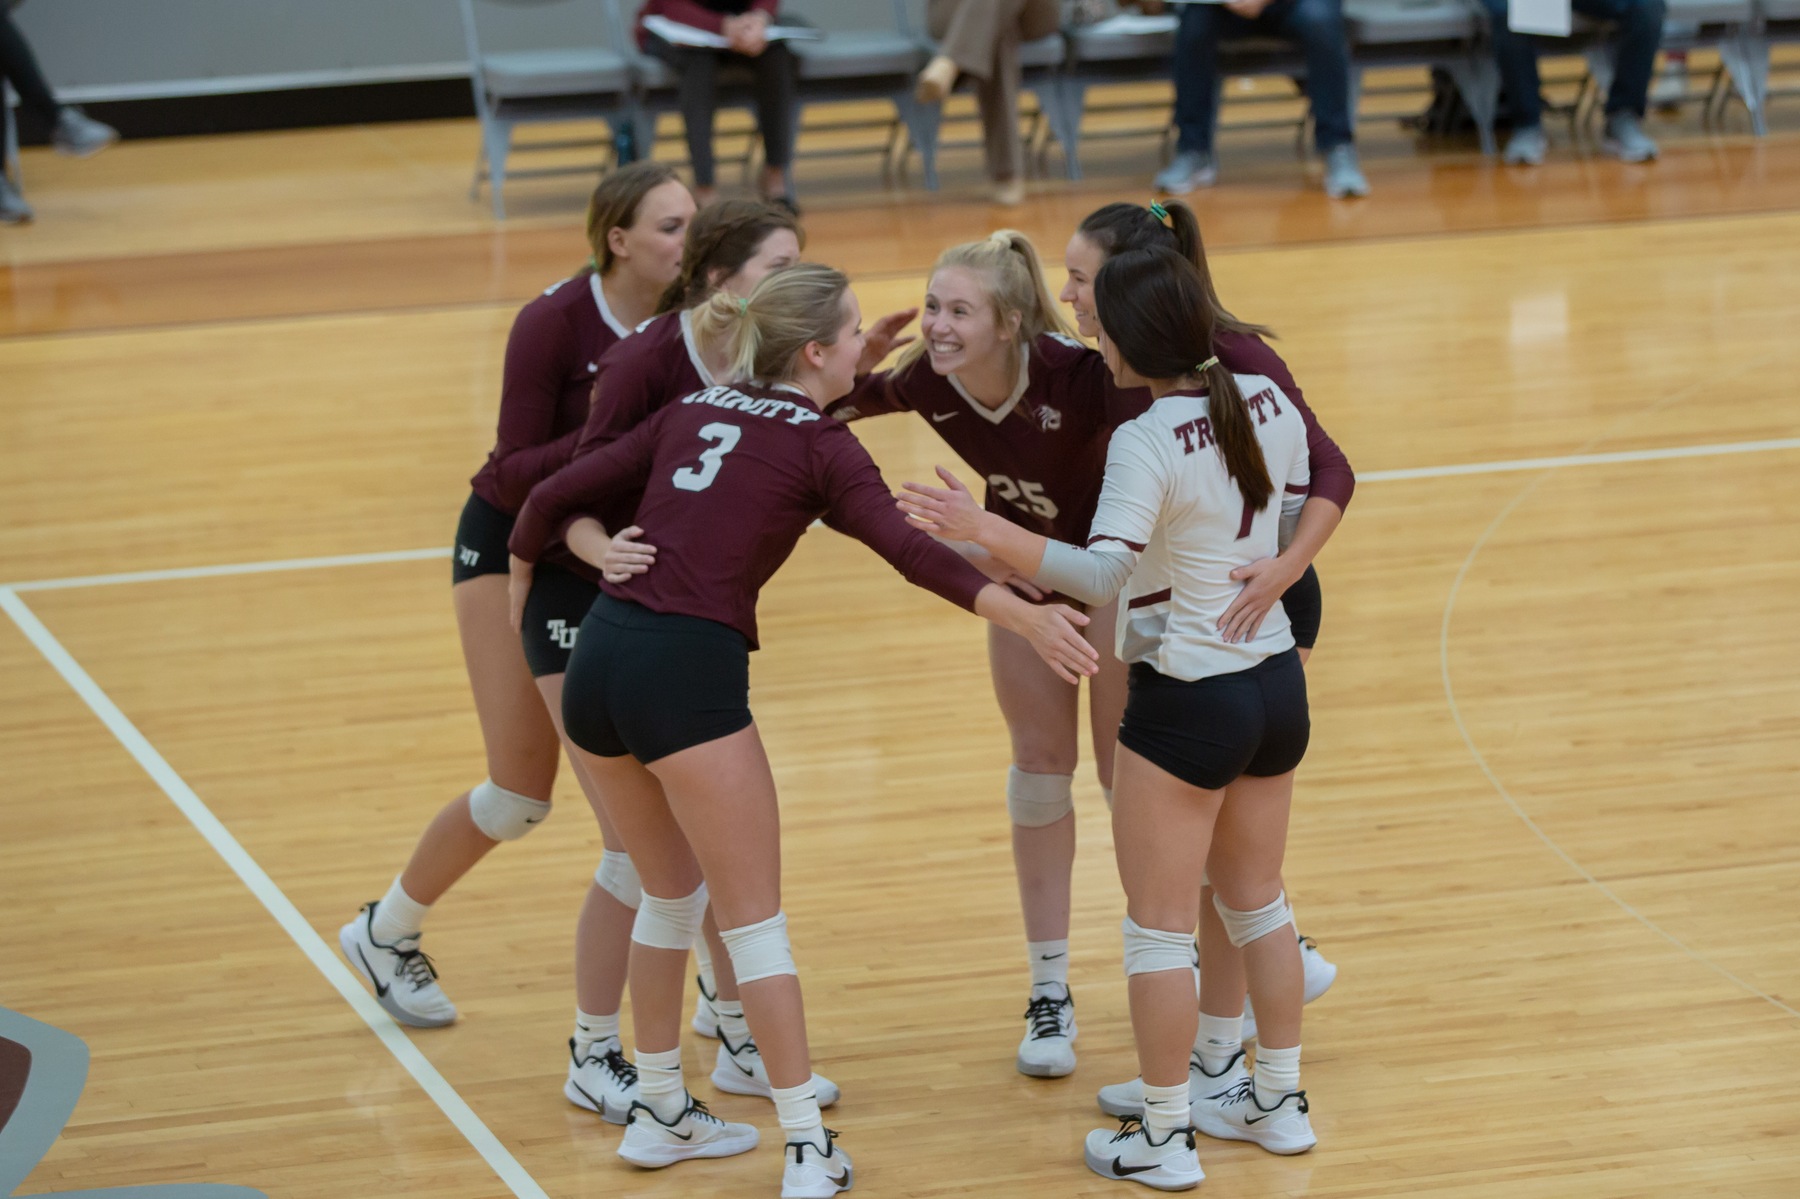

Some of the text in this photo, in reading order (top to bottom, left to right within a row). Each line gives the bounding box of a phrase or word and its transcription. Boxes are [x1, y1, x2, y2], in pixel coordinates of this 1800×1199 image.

[1173, 387, 1282, 456] TRTY
[672, 422, 742, 492] 3
[988, 474, 1059, 520] 25
[546, 619, 579, 649] TU
